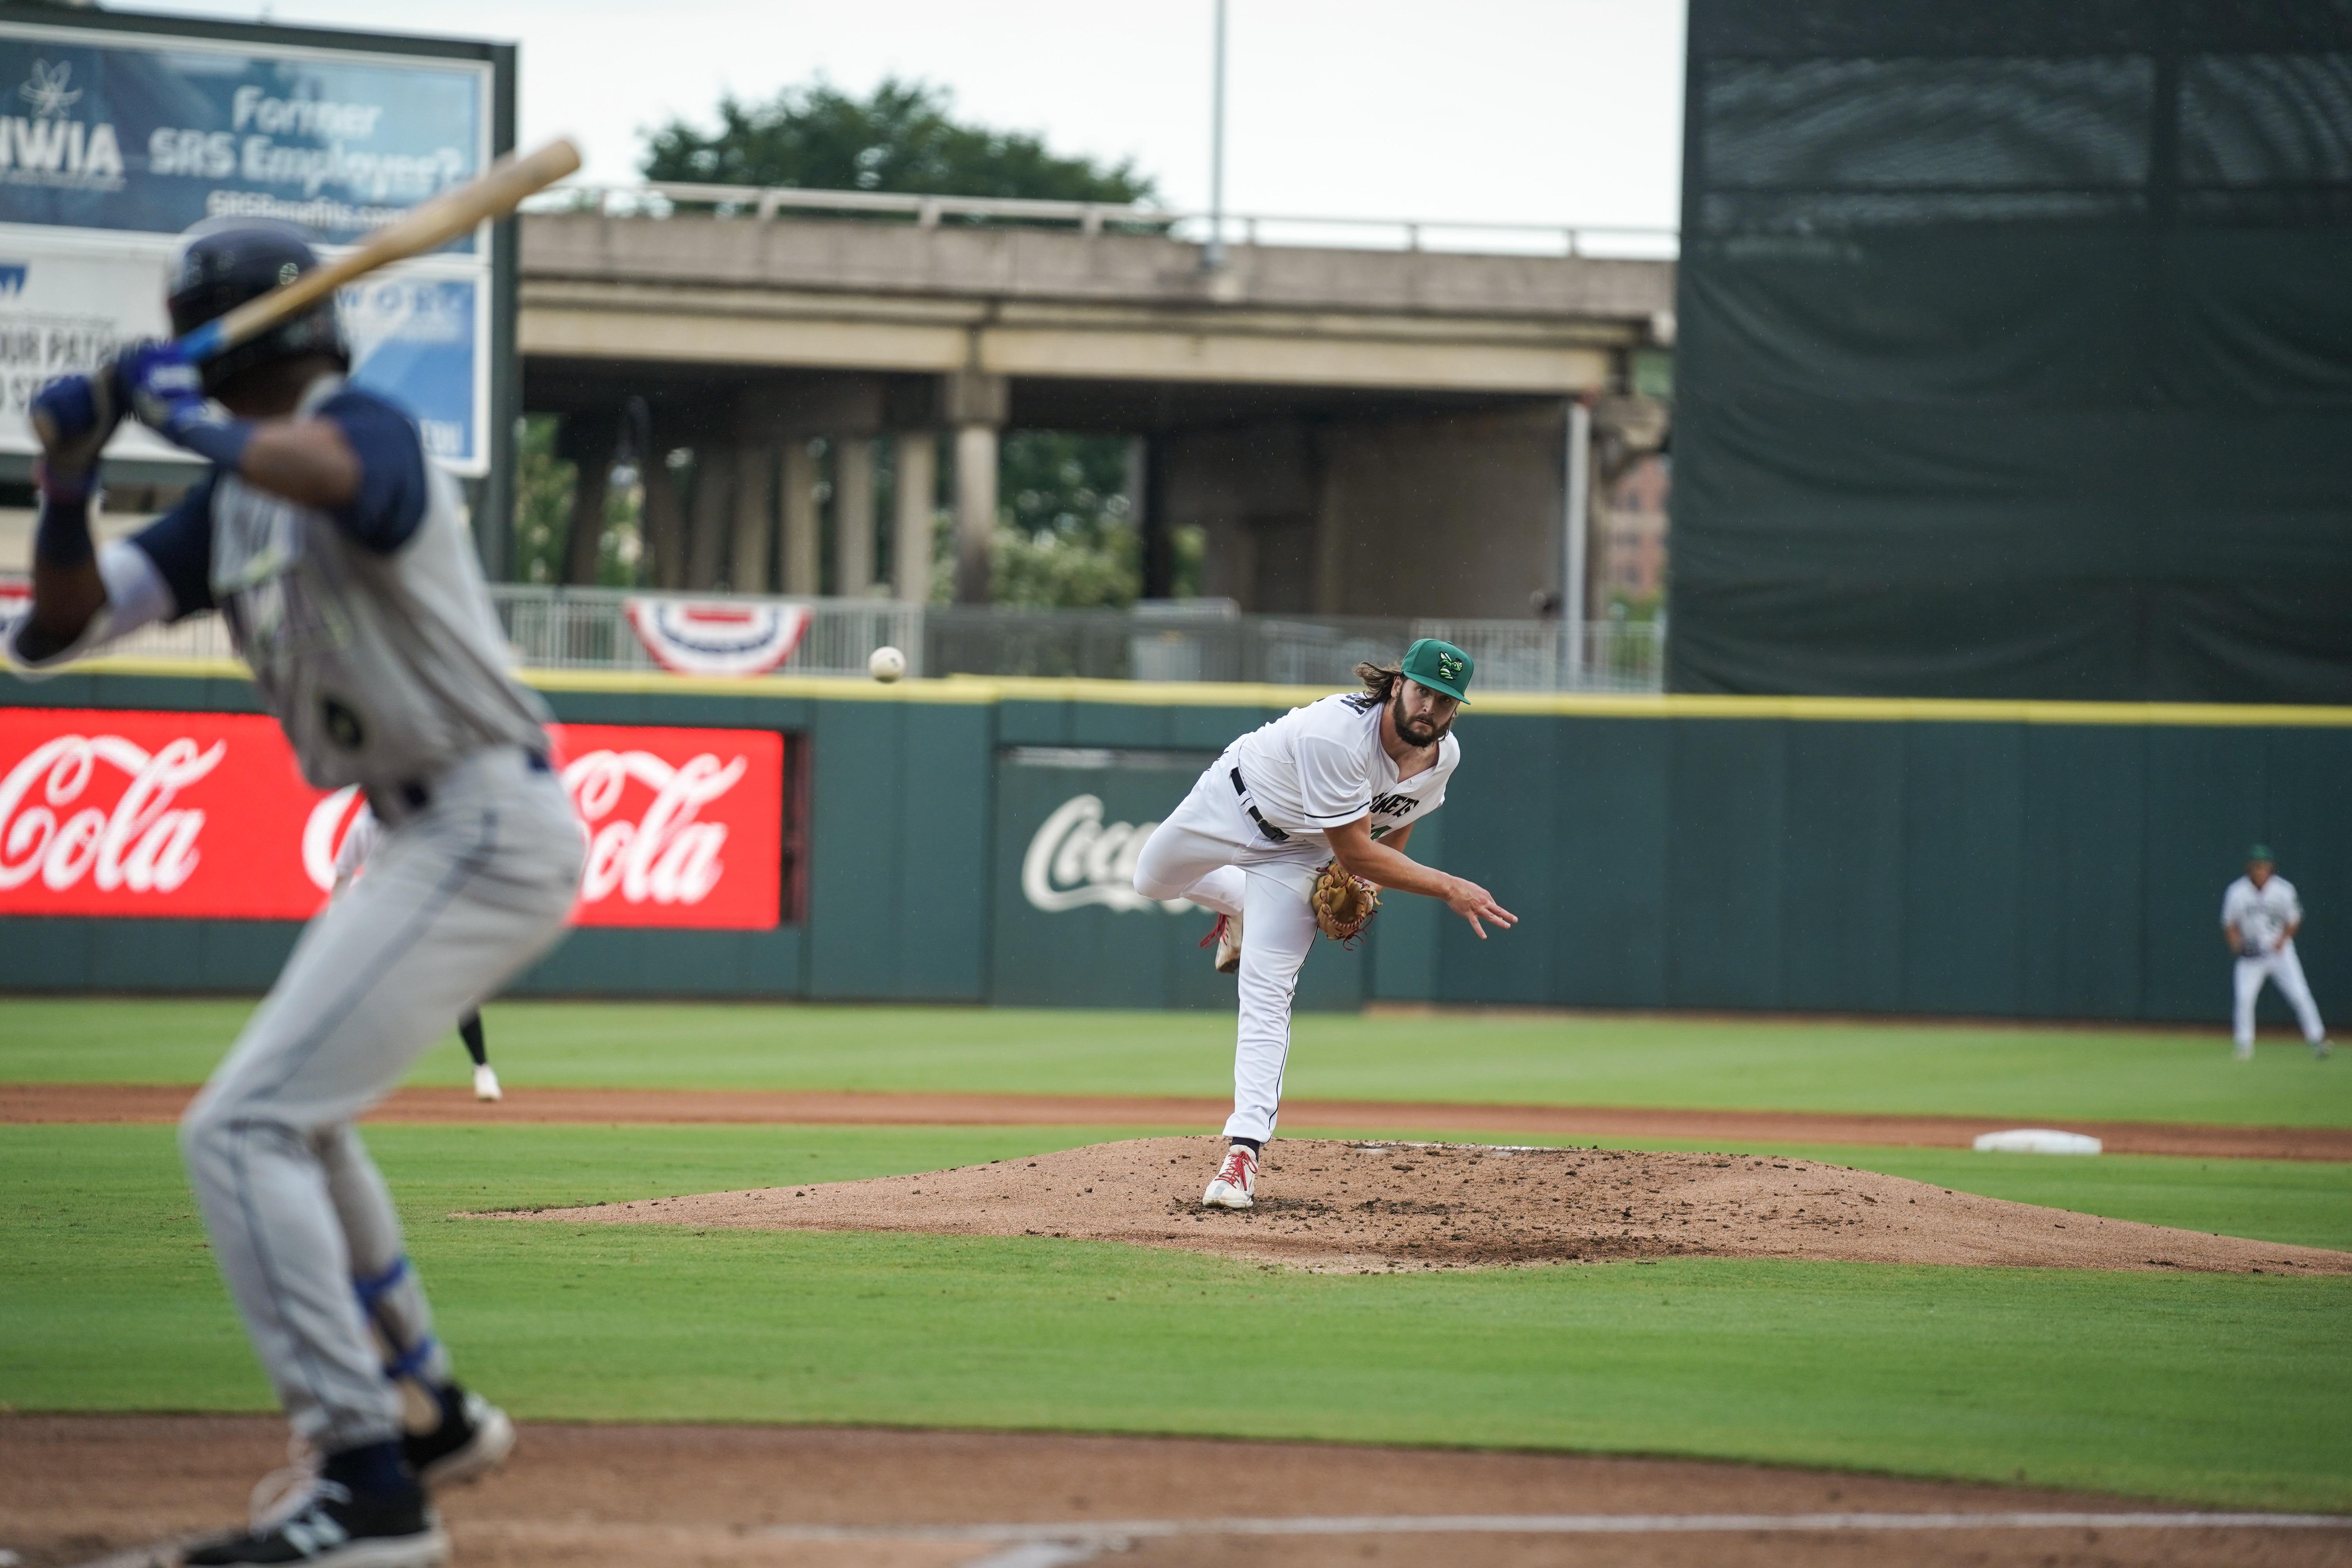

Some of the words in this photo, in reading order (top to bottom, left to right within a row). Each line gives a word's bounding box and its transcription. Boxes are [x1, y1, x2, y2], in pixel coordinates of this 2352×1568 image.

[233, 84, 382, 137] Former
[147, 126, 236, 179] SRS
[240, 133, 463, 200] Employee?
[0, 733, 228, 894] Cola
